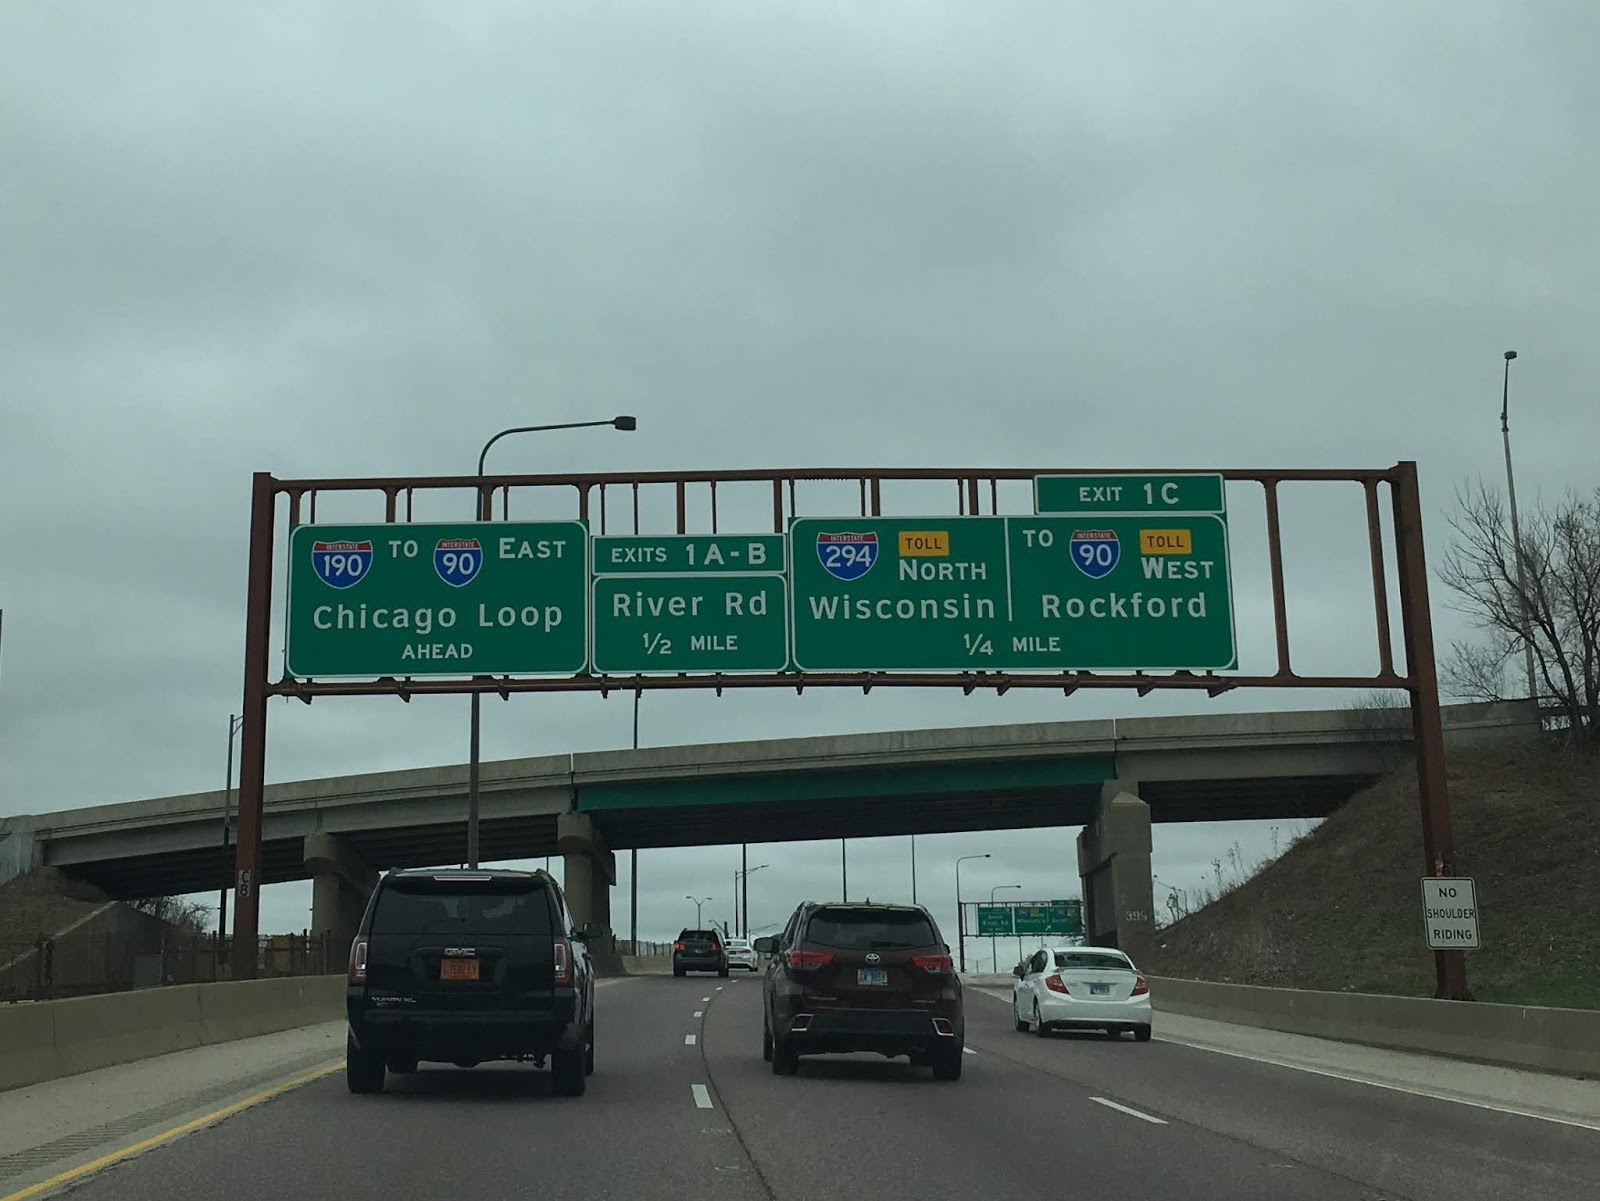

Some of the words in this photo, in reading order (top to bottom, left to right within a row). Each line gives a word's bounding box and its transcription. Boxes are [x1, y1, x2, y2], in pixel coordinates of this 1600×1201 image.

[1079, 487, 1123, 502] EXIT
[441, 540, 475, 548] INTERSTATE
[905, 537, 942, 550] TOLL
[1022, 529, 1054, 547] TO
[1079, 544, 1112, 566] 90
[1146, 535, 1185, 548] TOLL
[323, 554, 363, 577] 190
[388, 540, 418, 558] TO
[442, 553, 474, 575] 90
[499, 537, 566, 559] EAST
[611, 547, 667, 563] EXITS
[825, 545, 872, 567] 294
[899, 559, 986, 580] NORTH
[1141, 557, 1213, 579] WEST
[613, 591, 704, 617] River
[725, 590, 766, 616] Rd
[808, 593, 995, 620] Wisconsin
[1042, 592, 1207, 618] Rockford
[313, 604, 457, 634] Chicago
[478, 604, 562, 633] Loop
[401, 643, 473, 659] AHEAD
[690, 635, 738, 651] MILE
[1012, 636, 1061, 652] MILE
[1438, 888, 1457, 898] NO
[1427, 908, 1475, 919] SHOULDER
[1433, 929, 1472, 940] RIDING
[444, 947, 476, 956] GMC
